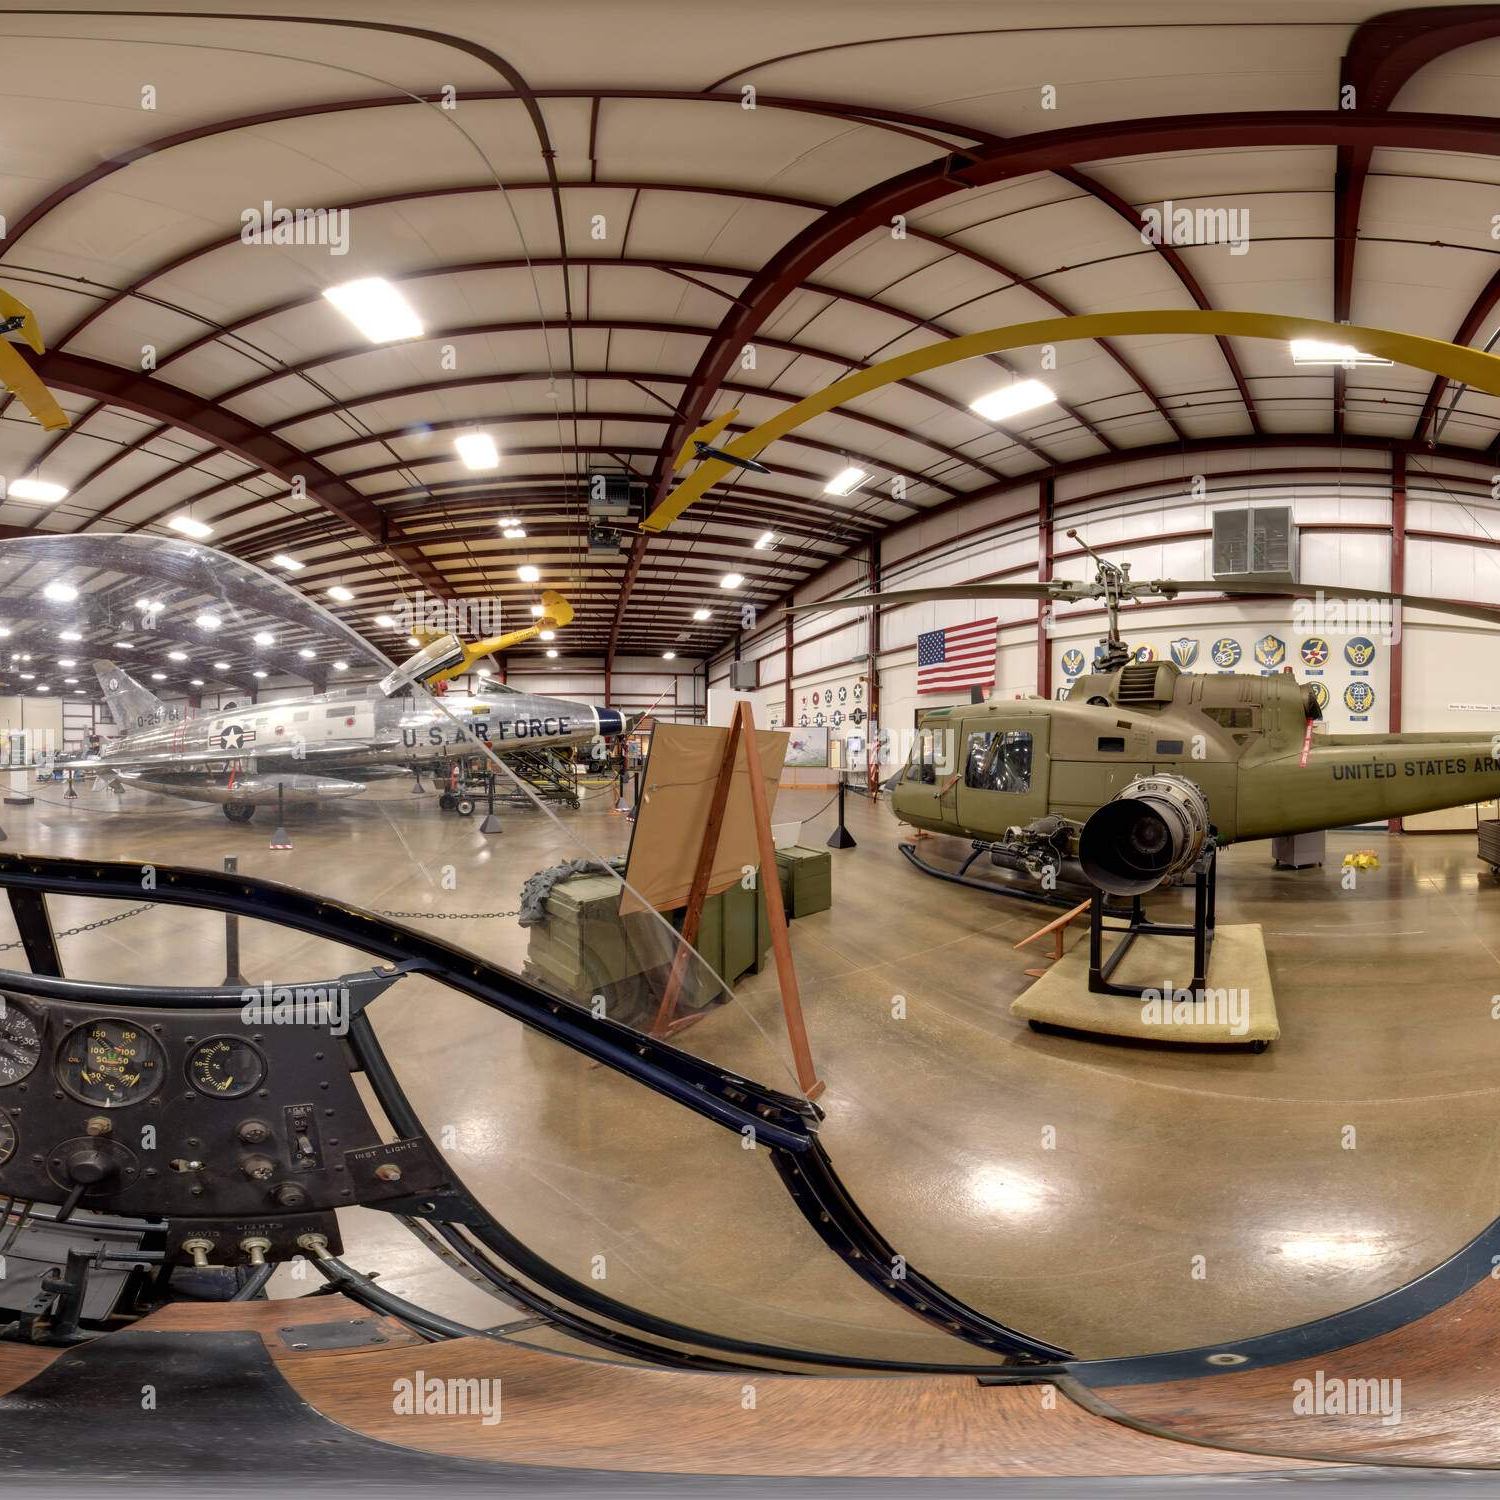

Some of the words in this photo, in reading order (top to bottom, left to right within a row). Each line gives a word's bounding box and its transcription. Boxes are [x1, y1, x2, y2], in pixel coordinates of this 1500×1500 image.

[1218, 640, 1234, 666] 5
[455, 723, 489, 743] AIR
[499, 717, 572, 739] FORCE
[1333, 762, 1397, 780] UNITED
[1404, 759, 1466, 776] STATES
[16, 1021, 26, 1029] 25
[2, 1066, 14, 1074] 40
[354, 1151, 378, 1159] INST
[385, 1142, 418, 1154] LIGHTS
